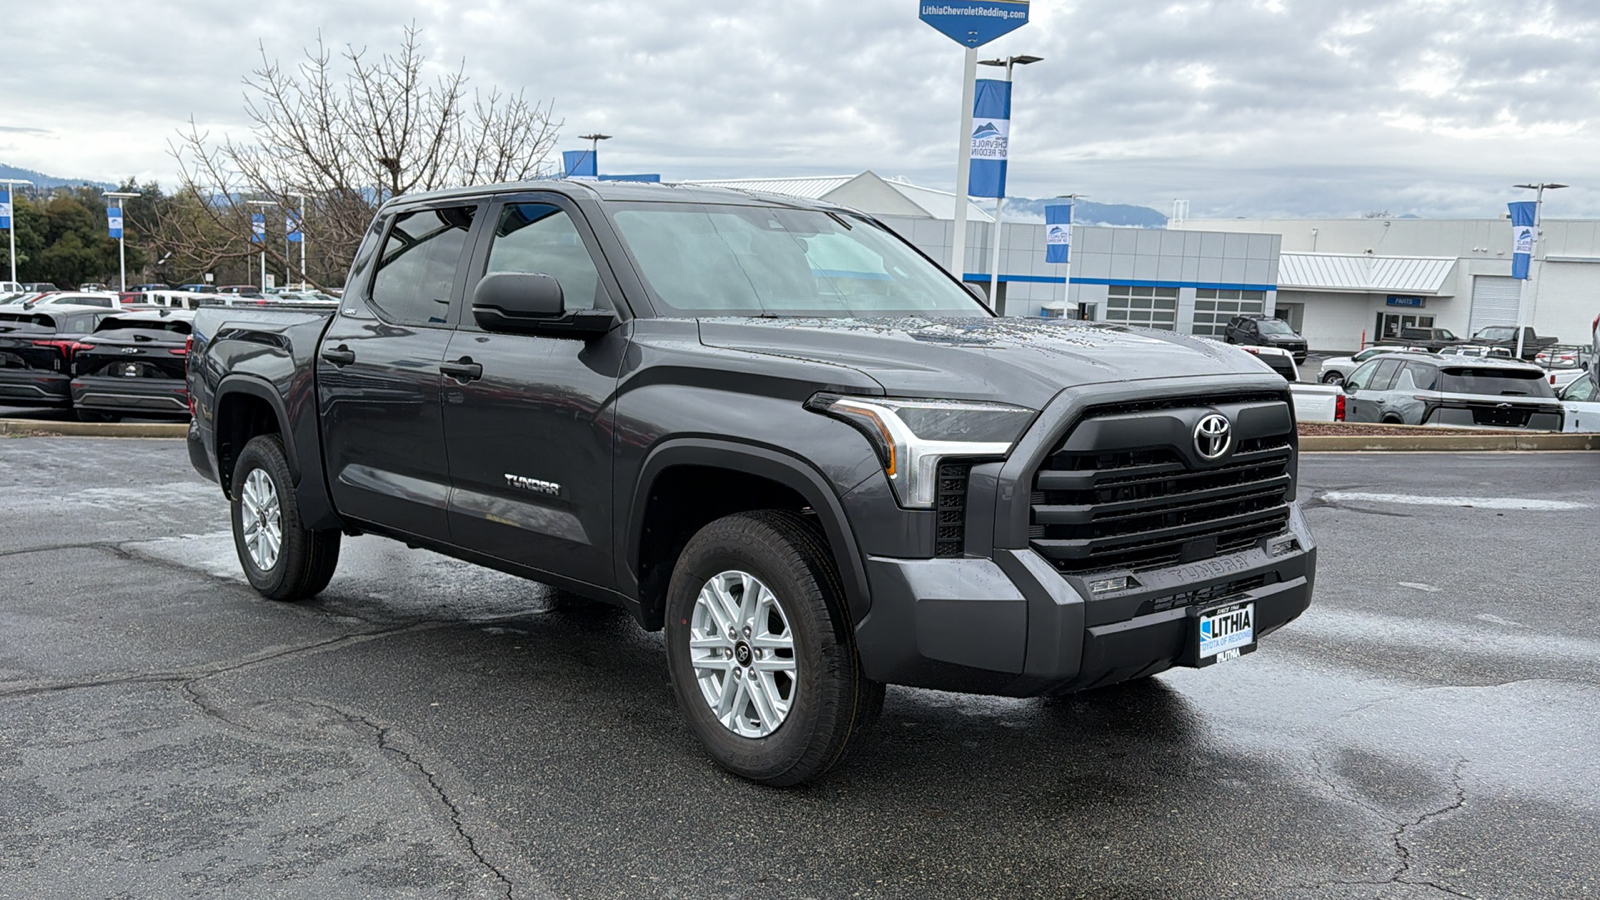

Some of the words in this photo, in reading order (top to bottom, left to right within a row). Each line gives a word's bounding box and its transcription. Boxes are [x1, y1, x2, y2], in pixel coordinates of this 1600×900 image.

[922, 5, 1026, 19] LithiaChevroletRedding.com
[1395, 297, 1413, 305] PARTS
[504, 473, 560, 496] TUNDRA
[1168, 554, 1250, 582] TUNDRA
[1211, 610, 1251, 639] LITHIA
[1220, 636, 1228, 646] OF
[1229, 629, 1252, 644] REDDING
